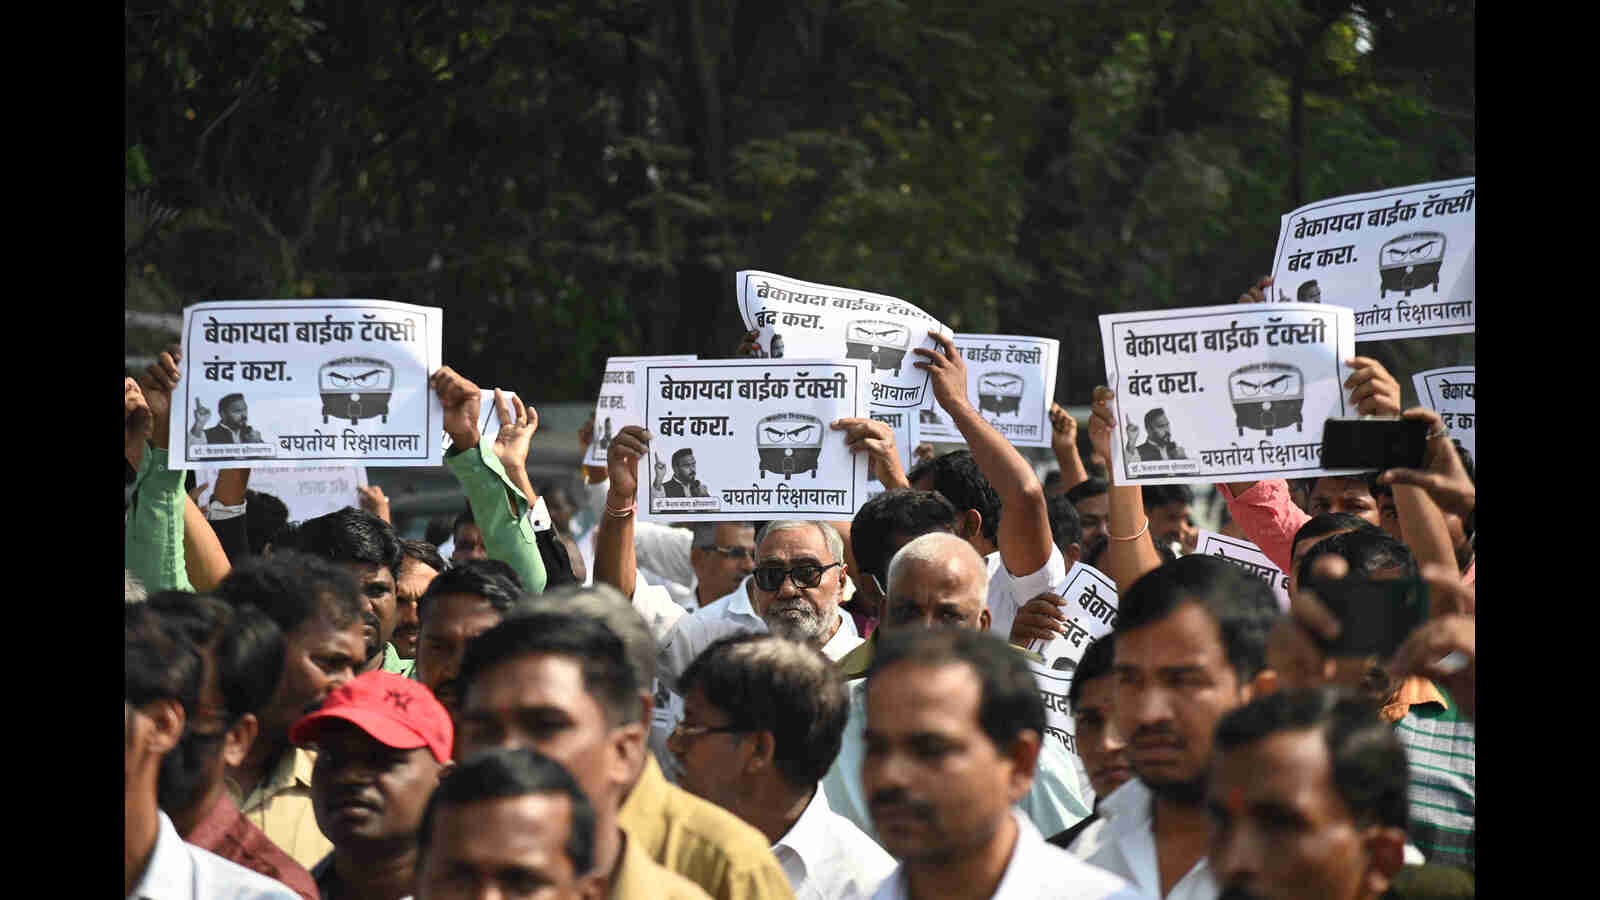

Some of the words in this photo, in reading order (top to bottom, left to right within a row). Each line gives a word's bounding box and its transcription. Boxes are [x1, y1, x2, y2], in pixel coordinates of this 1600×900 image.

[1295, 212, 1364, 239] बेकायदा
[1368, 200, 1420, 228] बाईक
[1423, 189, 1475, 218] टॅक्सी
[1288, 249, 1314, 272] बंद
[1316, 245, 1358, 266] करा.
[756, 281, 826, 306] बेकायदा
[832, 298, 883, 311] बाईक
[755, 307, 778, 328] बंद
[782, 311, 825, 330] करा.
[1354, 304, 1393, 327] घतोय
[1398, 300, 1473, 325] रिक्षावाला
[203, 316, 290, 344] बेकायदा
[294, 315, 355, 346] बाईक
[358, 314, 416, 342] टॅक्सी
[1124, 329, 1198, 358] बेकायदा
[1202, 321, 1260, 352] बाईक
[1263, 317, 1327, 347] टॅक्सी
[967, 344, 1001, 364] बाईक
[1006, 344, 1042, 364] टॅक्सी
[203, 355, 237, 382] बंद
[240, 360, 293, 382] करा.
[659, 374, 734, 401] बेकायदा
[736, 373, 790, 402] बाईक
[793, 371, 848, 400] टॅक्सी
[870, 382, 920, 400] क्षावाला
[1128, 369, 1153, 396] बंद
[1156, 371, 1204, 394] करा.
[659, 411, 687, 437] बंद
[690, 415, 734, 437] करा.
[279, 429, 337, 452] बघतोय
[341, 429, 421, 455] रिक्षावाला
[1200, 443, 1255, 467] बघतोय
[1258, 440, 1325, 467] रिक्षावा
[721, 483, 773, 505] बघतोय
[775, 483, 847, 508] रिक्षावाला
